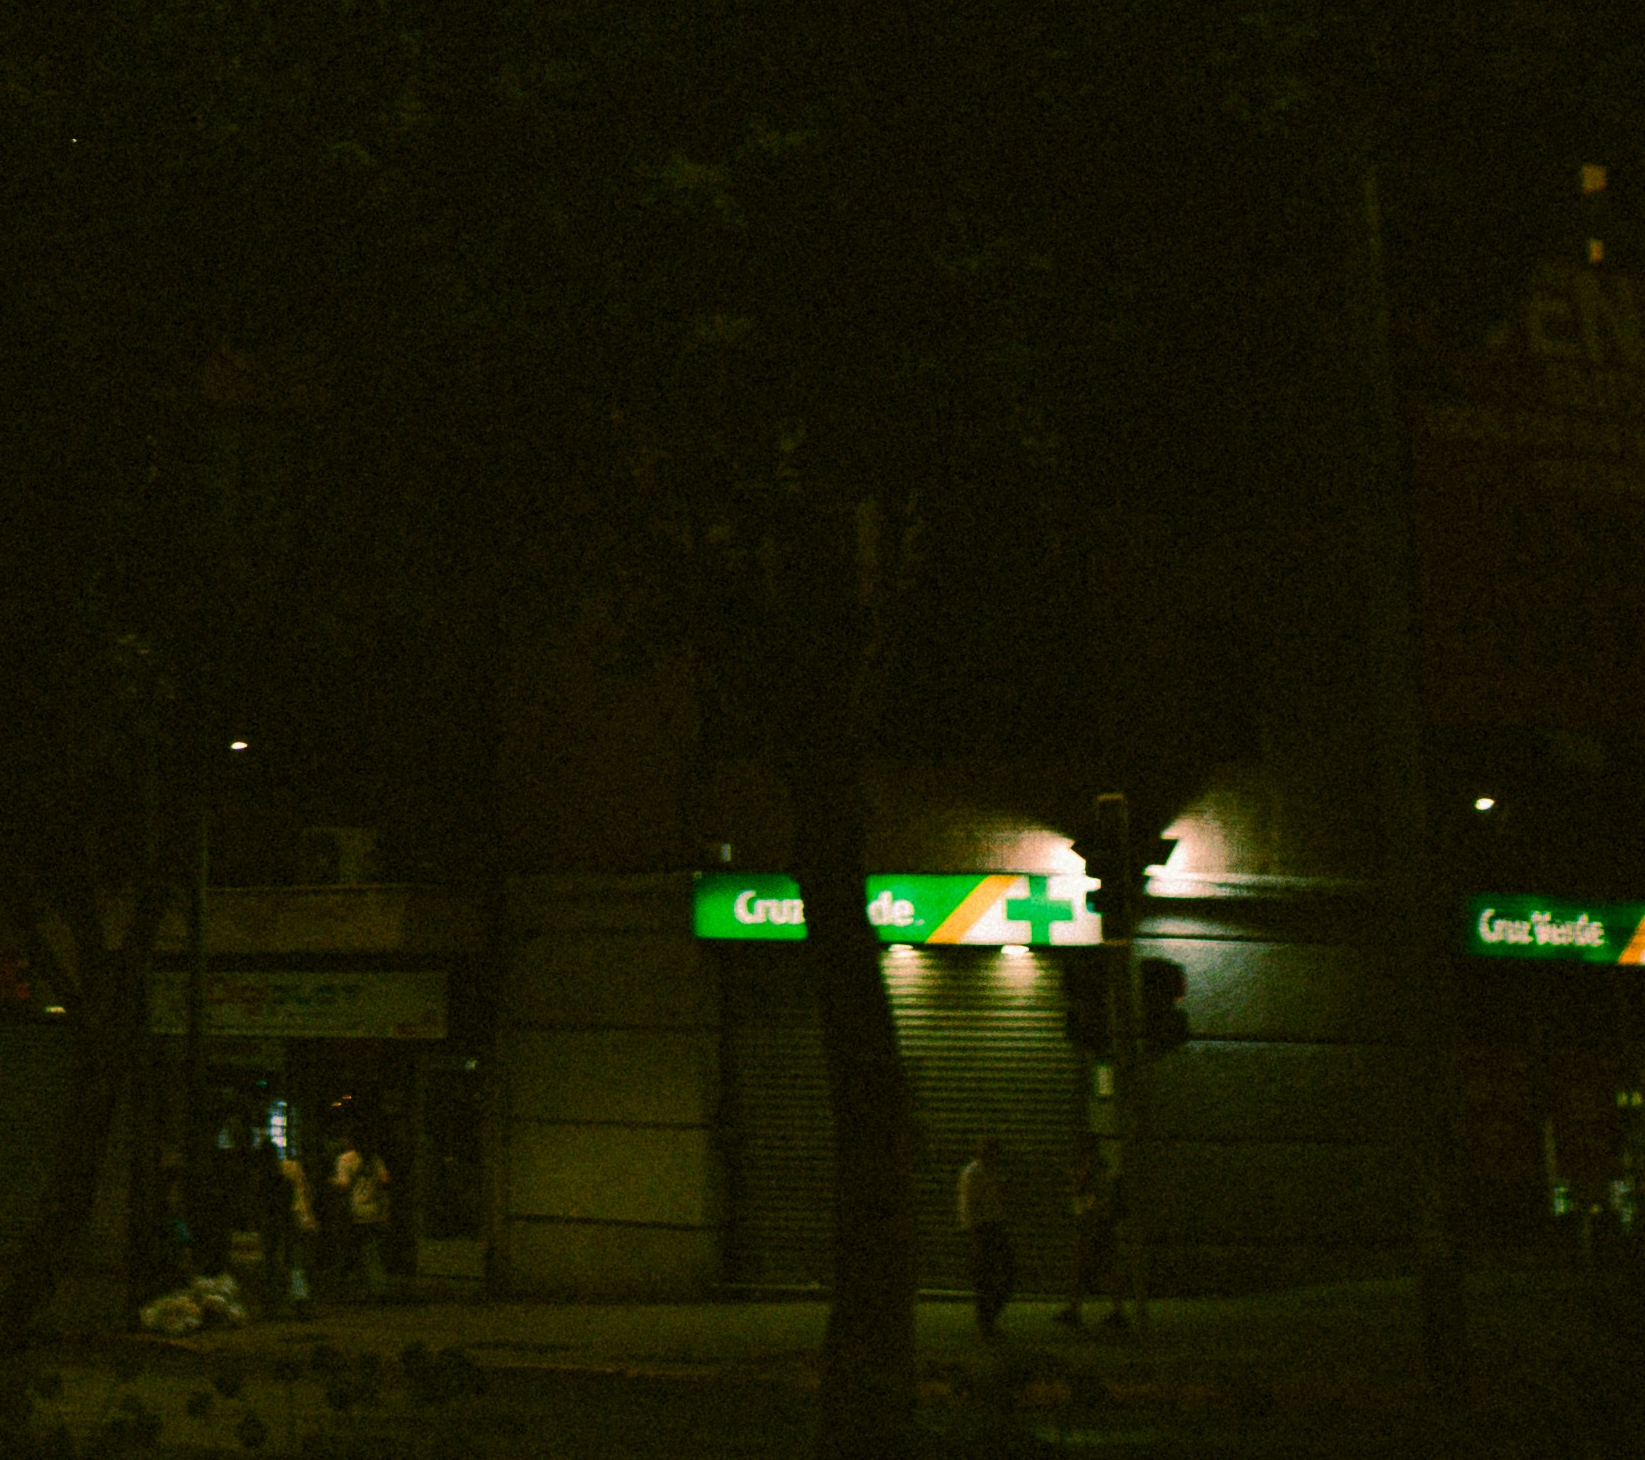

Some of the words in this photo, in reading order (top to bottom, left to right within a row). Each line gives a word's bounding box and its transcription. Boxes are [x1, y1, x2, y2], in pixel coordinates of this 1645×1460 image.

[733, 890, 806, 925] Cruz
[1479, 908, 1534, 944] Cruz
[1530, 911, 1605, 947] Verde
